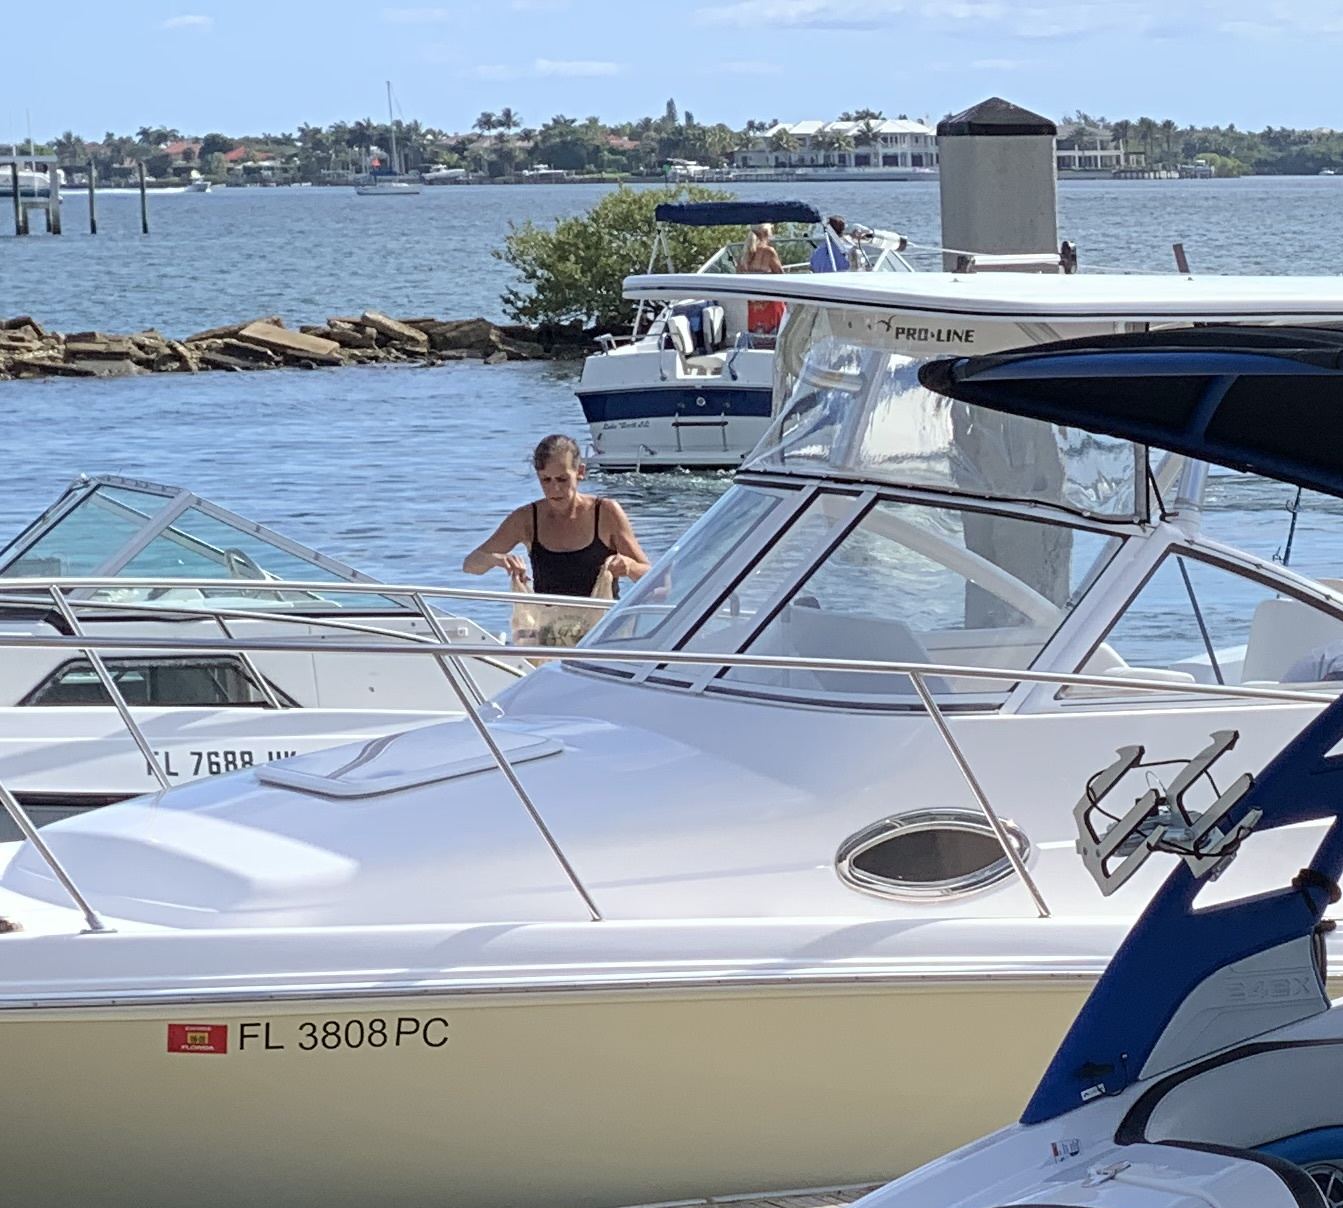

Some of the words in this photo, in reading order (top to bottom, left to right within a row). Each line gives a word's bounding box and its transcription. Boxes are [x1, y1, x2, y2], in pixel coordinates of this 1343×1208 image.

[239, 1023, 284, 1050] FL
[298, 1018, 388, 1050] 3808
[395, 1017, 449, 1047] PC
